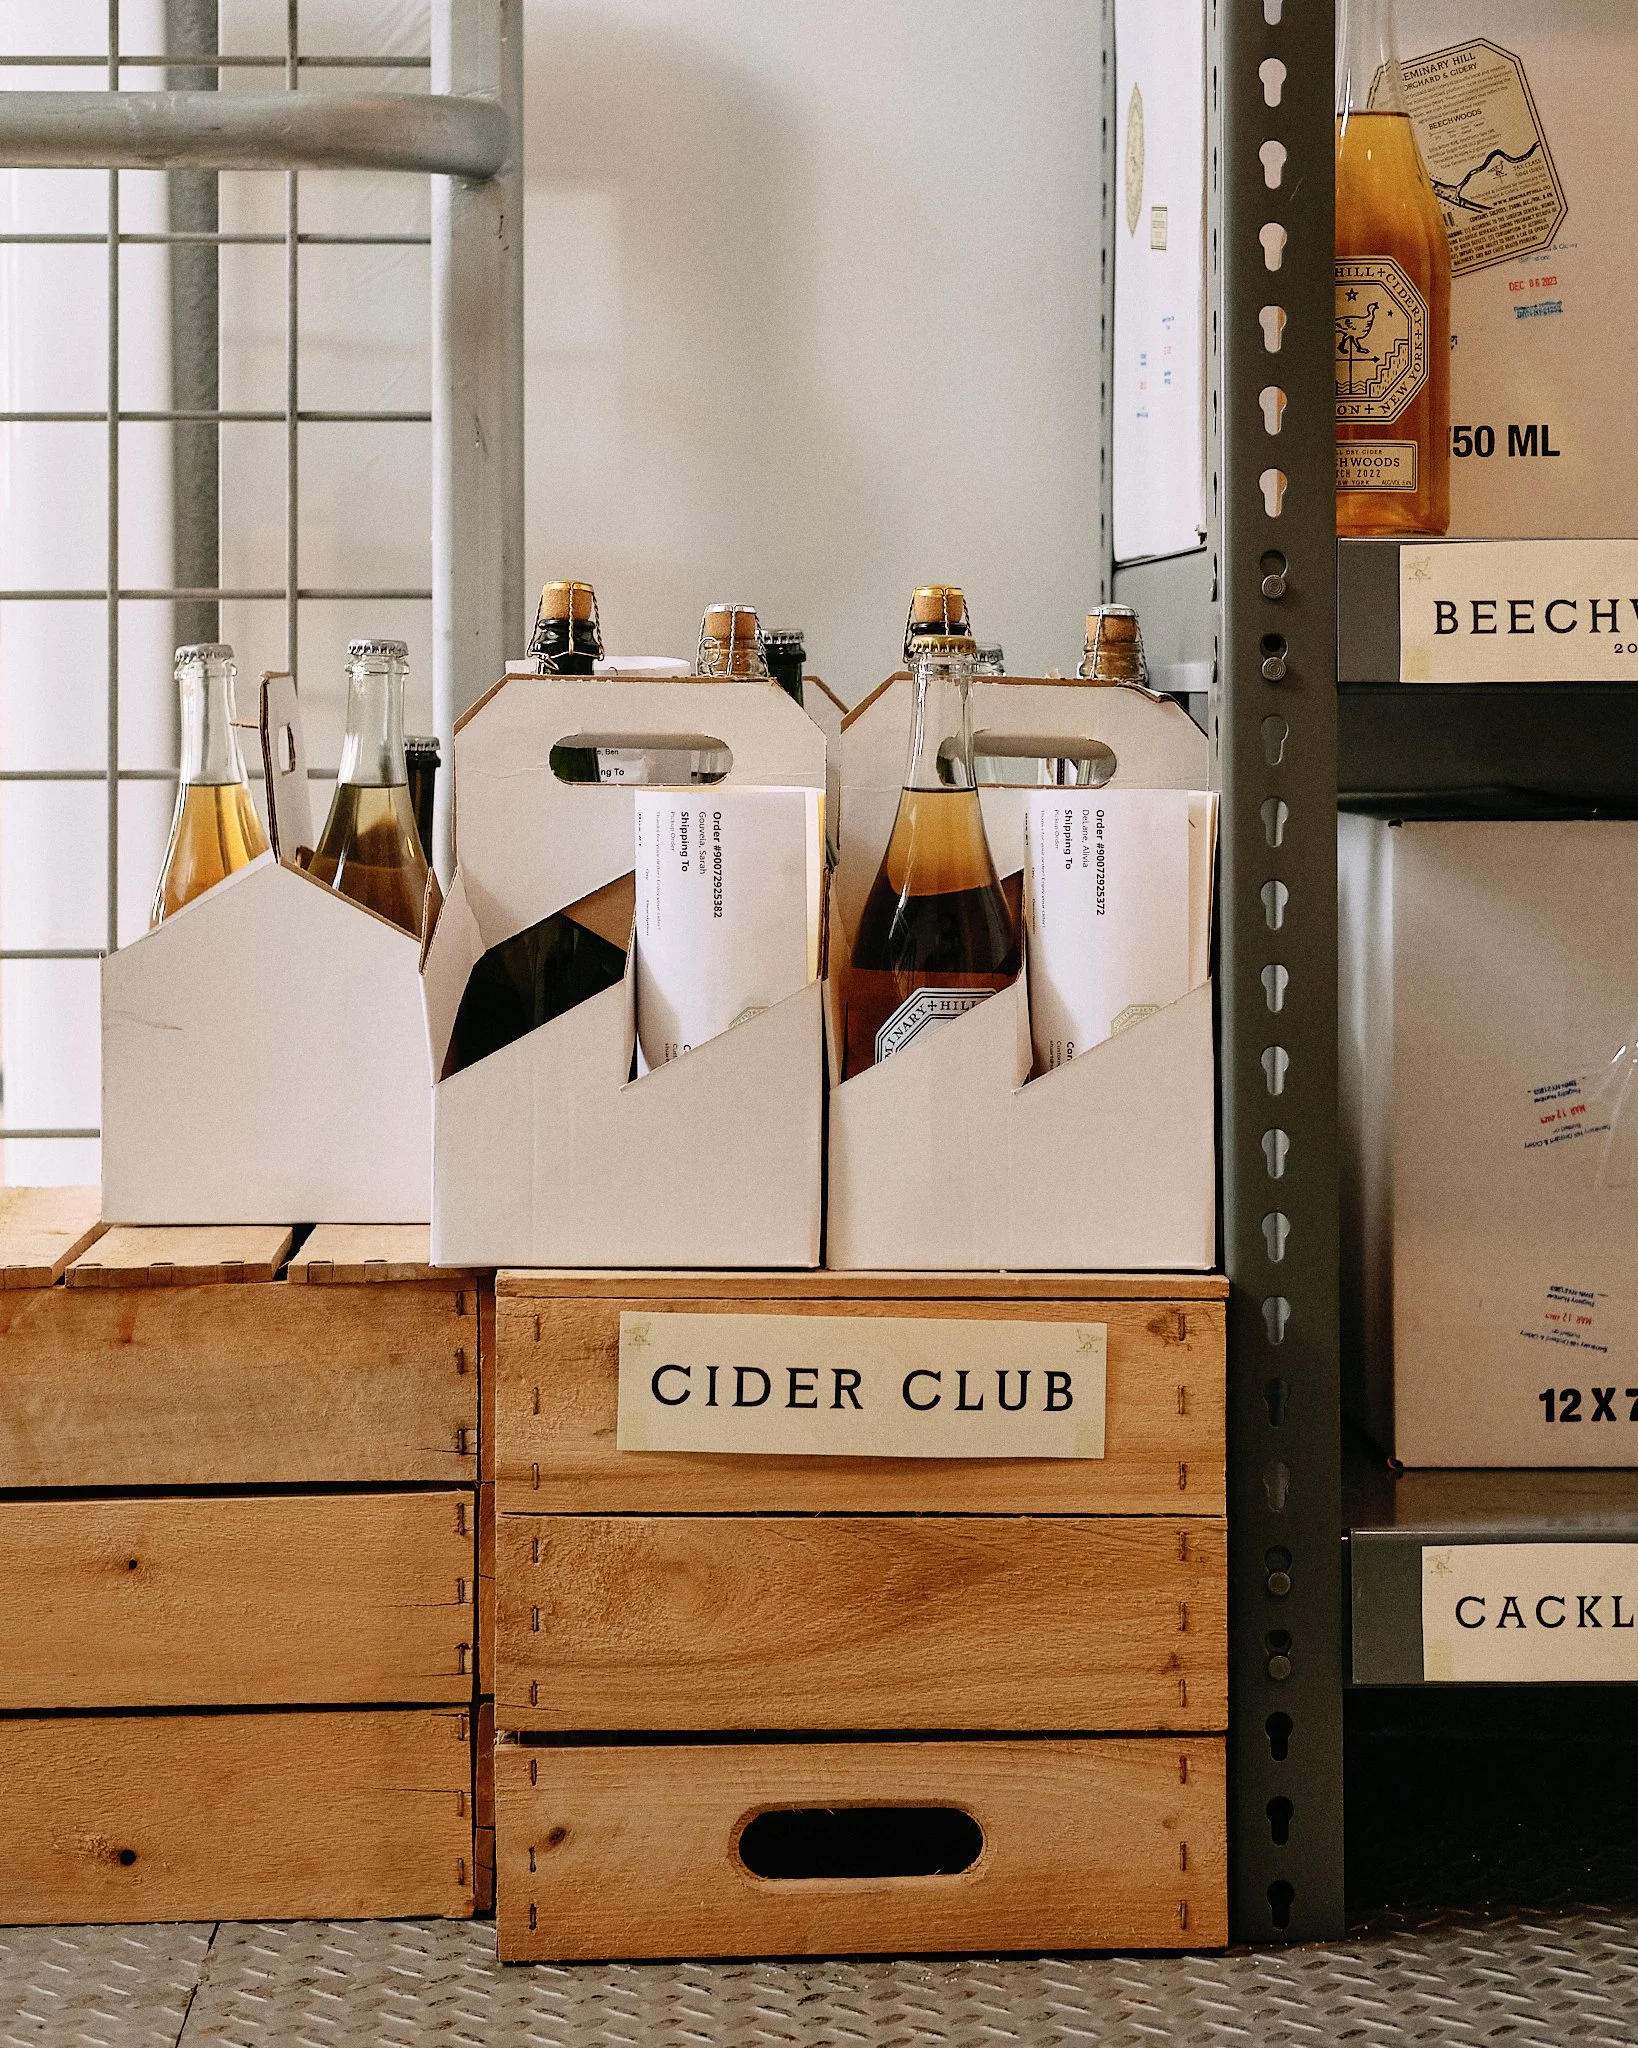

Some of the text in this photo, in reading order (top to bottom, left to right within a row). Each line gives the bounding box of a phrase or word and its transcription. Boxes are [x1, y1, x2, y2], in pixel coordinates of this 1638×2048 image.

[1402, 52, 1476, 81] EMINARY HILL
[1450, 62, 1477, 76] CIDERY
[1385, 273, 1422, 326] CIDERY
[1508, 281, 1524, 291] DEC
[1379, 343, 1422, 414] NEW YORK
[1449, 424, 1561, 457] 50 ML
[1357, 470, 1381, 478] 2022
[1433, 599, 1638, 635] BEECH
[614, 768, 625, 776] To
[679, 811, 689, 872] Shipping To
[1062, 809, 1072, 870] Shipping To
[1081, 845, 1090, 868] Alivia
[698, 850, 706, 874] Sarah
[712, 811, 723, 918] Order #90072925382
[1095, 809, 1105, 916] Order #90072925372
[1576, 1315, 1592, 1326] MAR
[651, 1364, 1074, 1412] CIDER CLUB
[1539, 1388, 1582, 1423] 12
[1591, 1387, 1617, 1422] X
[1455, 1595, 1634, 1629] CACKL
